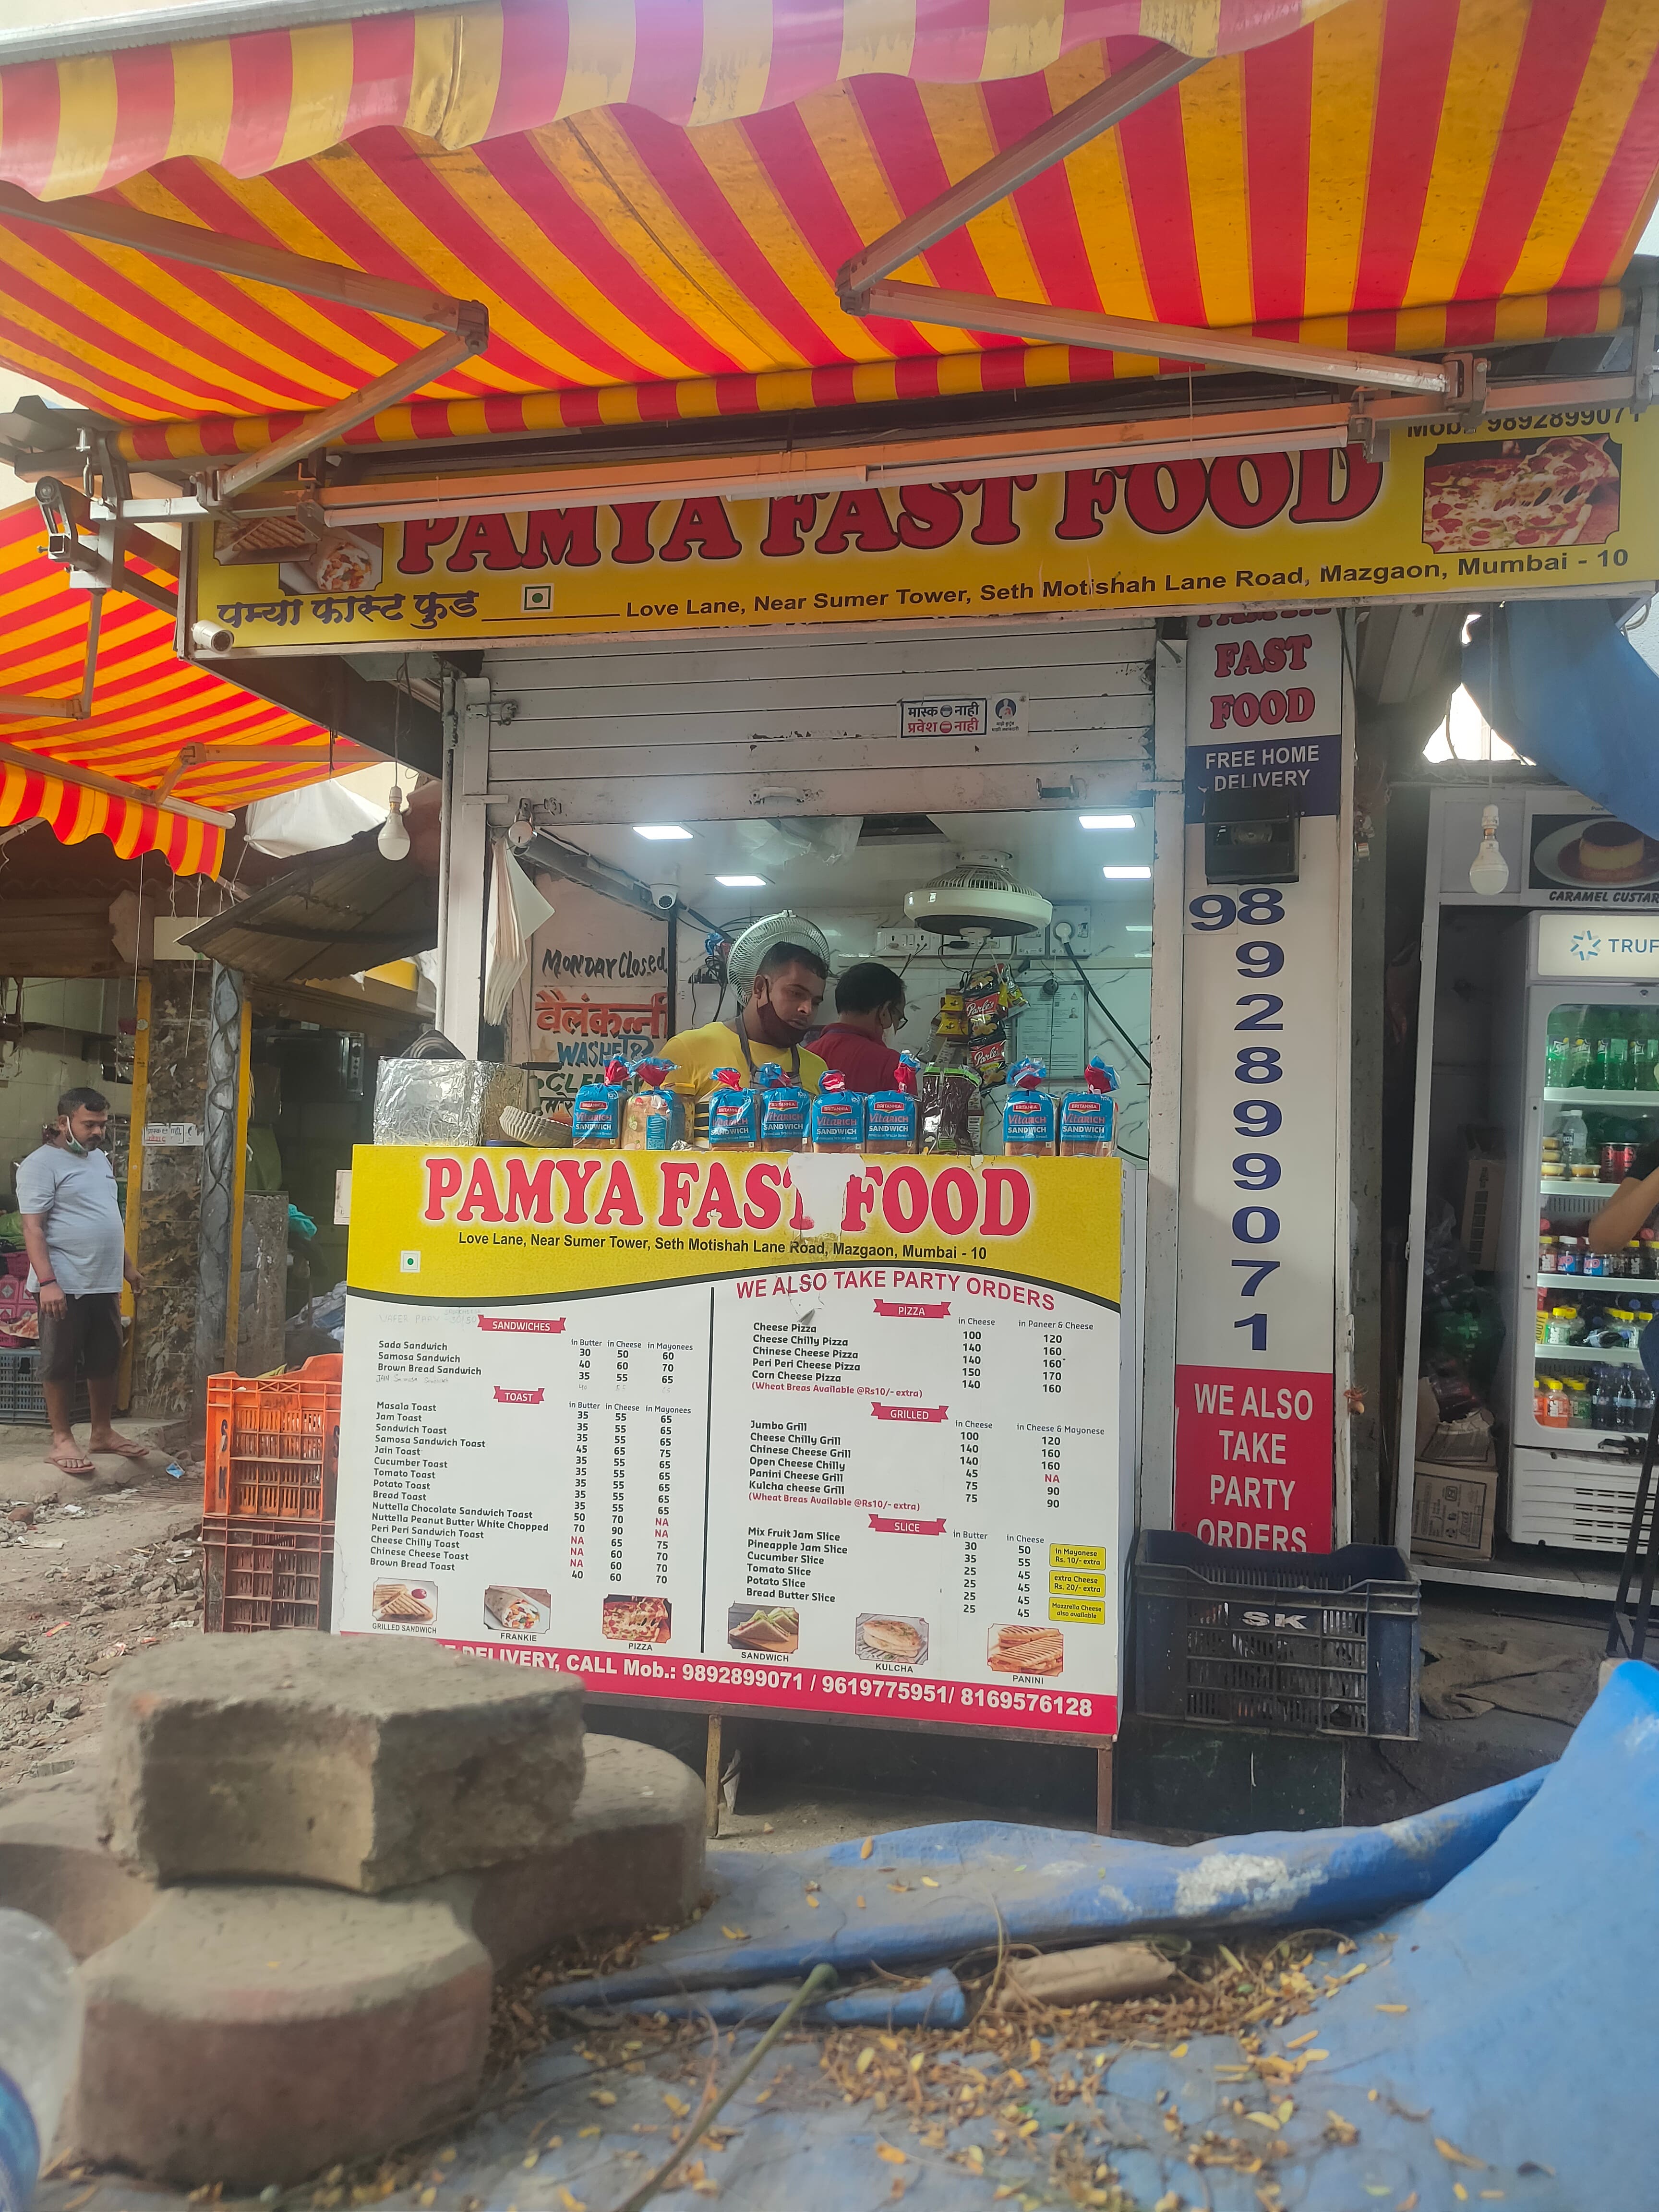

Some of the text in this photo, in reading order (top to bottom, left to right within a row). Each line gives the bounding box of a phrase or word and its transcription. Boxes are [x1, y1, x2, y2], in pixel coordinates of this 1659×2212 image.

[397, 444, 1383, 574] PAMYA FAST FOOD
[626, 601, 679, 618] Love
[686, 599, 745, 616] Lane,
[754, 595, 807, 613] Near
[813, 591, 890, 610] Sumer
[895, 587, 971, 605] Tower,
[980, 582, 1034, 601] Seth
[1043, 576, 1156, 598] Motishah
[1165, 574, 1226, 592] Lane
[1236, 566, 1310, 588] Road,
[1320, 562, 1447, 584] Mazgaon,
[1458, 552, 1567, 577] Mumbai
[1597, 549, 1629, 567] 10
[216, 590, 480, 630] पम्या फास्ट फुड
[1214, 634, 1312, 678] FAST
[907, 701, 979, 718] मास्क नाही
[1210, 687, 1315, 730] FOOD
[907, 719, 938, 733] प्रवेश
[954, 717, 979, 732] नाही
[1205, 745, 1320, 769] FREE HOME
[1214, 769, 1310, 792] DELIVERY
[1549, 891, 1609, 902] CARAMEL
[1608, 938, 1659, 953] TRUF
[966, 999, 994, 1016] Parle's
[424, 1157, 644, 1226] PAMYA
[841, 1165, 1031, 1236] FOOD
[459, 1232, 489, 1245] Love
[493, 1232, 527, 1248] Lane,
[531, 1233, 561, 1247] Near
[564, 1234, 606, 1248] Sumer
[609, 1236, 651, 1251] Tower,
[655, 1237, 684, 1250] Seth
[688, 1238, 748, 1252] Motishah
[753, 1240, 785, 1253] Lane
[790, 1240, 829, 1257] Road,
[833, 1242, 898, 1259] Mazgaon,
[902, 1244, 958, 1260] Mumbai
[971, 1246, 987, 1260] 10
[736, 1270, 1056, 1311] WE ALSO TAKE PARTY ORDERS
[898, 1305, 926, 1316] PIZZA
[492, 1320, 551, 1332] SANDWICHES
[379, 1340, 674, 1360] Sada Sandwich 30 50 60
[571, 1338, 578, 1346] in
[580, 1338, 602, 1347] Butter
[607, 1339, 614, 1347] in
[616, 1340, 642, 1349] Cheese
[656, 1343, 694, 1352] Mayonees
[752, 1358, 1061, 1381] Peri Peri Cheese Pizza 150 170
[505, 1392, 533, 1402] TOAST
[752, 1382, 922, 1398] (Wheat Breas Available @Rs10/- extra)
[1194, 1383, 1313, 1420] WE ALSO
[890, 1409, 929, 1420] GRILLED
[1219, 1430, 1286, 1465] TAKE
[1210, 1474, 1296, 1511] PARTY
[372, 1513, 668, 1538] Nuttella Peanut Butter White Chopped 70 90 NA
[894, 1522, 921, 1533] SLICE
[1197, 1518, 1307, 1553] ORDERS
[1063, 1548, 1097, 1557] Mayonese
[1066, 1584, 1082, 1592] 20/-
[1073, 1575, 1098, 1584] Cheese
[372, 1623, 437, 1634] GRILLED SANDWICH
[1242, 1611, 1308, 1630] SK
[500, 1633, 537, 1642] FRANKIE
[628, 1643, 653, 1651] PIZZA
[741, 1651, 790, 1662] SANDWICH
[876, 1663, 914, 1673] KULCHA
[566, 1655, 617, 1674] CALL
[624, 1659, 676, 1679] Mob.:
[682, 1664, 802, 1690] 9892899071
[961, 1688, 1093, 1717] 8169576128
[1012, 1674, 1044, 1684] PANINI
